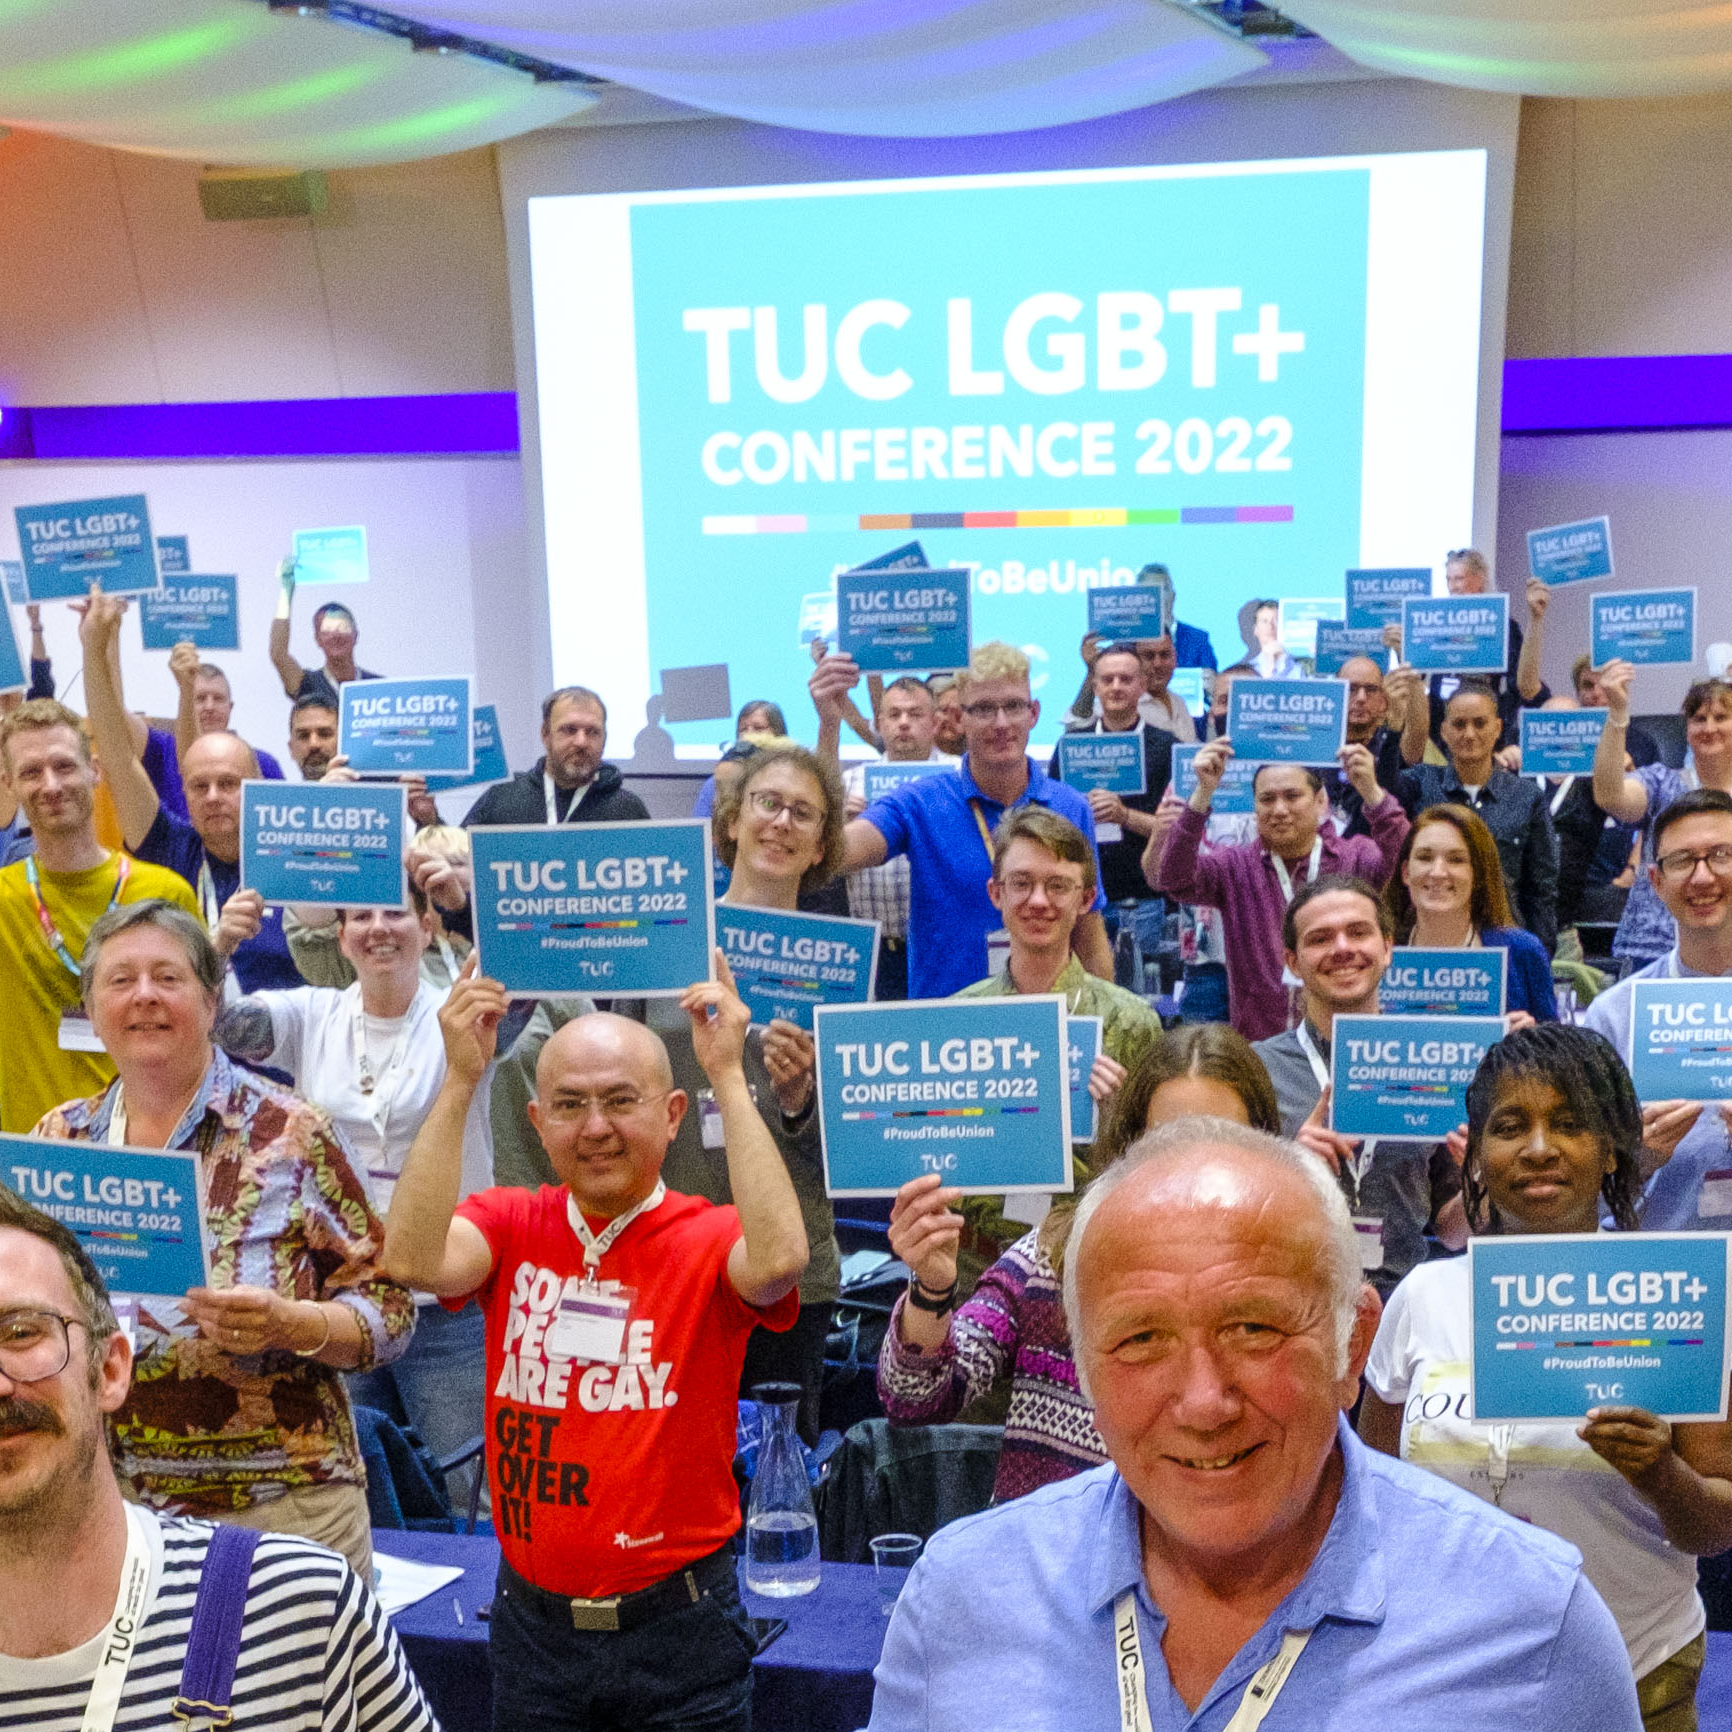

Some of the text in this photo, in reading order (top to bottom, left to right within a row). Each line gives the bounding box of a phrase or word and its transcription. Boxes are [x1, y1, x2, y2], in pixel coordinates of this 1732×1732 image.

[683, 286, 1305, 404] TUC LGBT+
[701, 415, 1294, 488] CONFERENCE 2022
[25, 512, 140, 541] TUC LGBT+
[845, 590, 889, 611] TUC
[894, 588, 957, 608] LGBT+
[349, 694, 459, 716] TUC LGBT+
[1237, 694, 1335, 711] TUC LGBT+
[253, 805, 389, 830] TUC LGBT+
[256, 831, 387, 848] CONFERENCE 2022
[488, 856, 689, 892] TUC LGBT+
[496, 893, 687, 916] CONFERENCE 2022
[1646, 1001, 1707, 1025] TUC
[834, 1035, 1040, 1077] TUC LGBT+
[840, 1078, 1037, 1103] CONFERENCE 2022
[920, 1153, 957, 1171] TUC
[1489, 1271, 1708, 1307] TUC LGBT+
[1495, 1310, 1704, 1334] CONFERENCE 2022
[494, 1353, 679, 1413] ARE GAY.
[1583, 1382, 1622, 1400] TUC
[495, 1406, 561, 1459] GET
[497, 1451, 591, 1507] OVER
[499, 1494, 532, 1544] IT!
[105, 1616, 134, 1666] TUC
[1118, 1615, 1139, 1671] TUC
